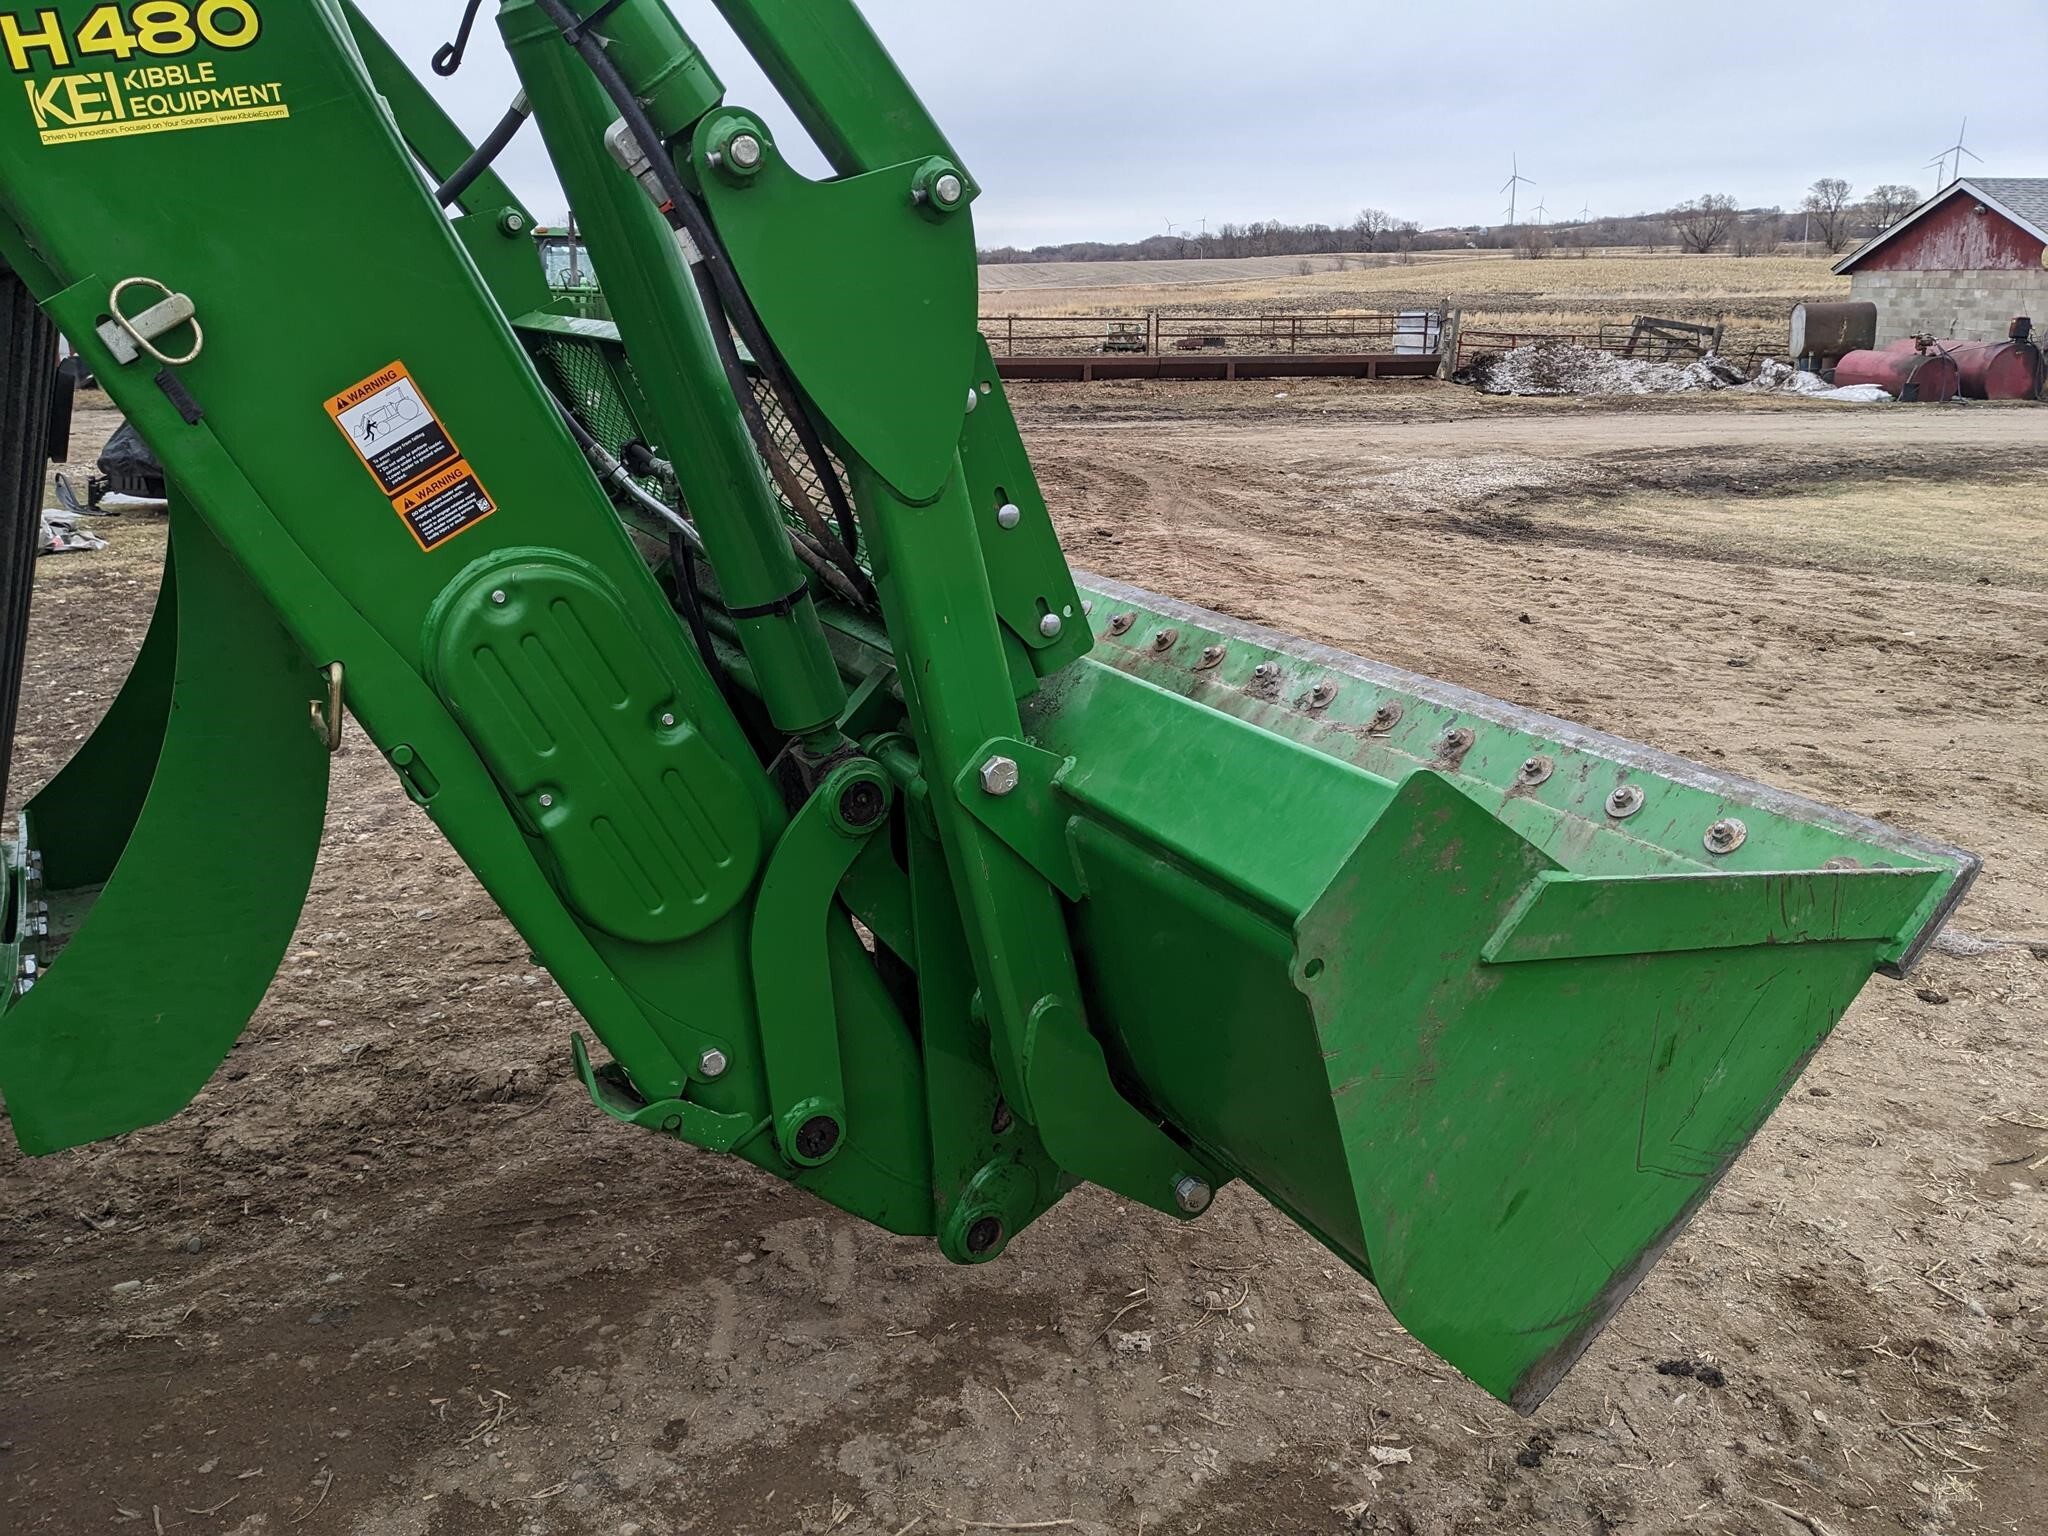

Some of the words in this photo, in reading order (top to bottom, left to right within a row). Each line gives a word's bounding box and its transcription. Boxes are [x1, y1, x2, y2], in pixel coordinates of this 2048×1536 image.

[123, 61, 217, 91] KIBBLE
[24, 71, 126, 128] KEI
[129, 82, 283, 118] EQUIPMENT
[41, 130, 67, 143] Driven
[68, 129, 77, 140] by
[119, 121, 150, 133] Focused
[151, 121, 162, 129] on
[161, 118, 179, 128] Your
[347, 370, 397, 402] WARNING
[379, 452, 390, 461] avoid
[390, 446, 402, 454] injury
[411, 432, 425, 441] falling
[386, 465, 400, 475] service
[400, 458, 412, 466] under
[416, 448, 429, 457] raised
[411, 443, 427, 454] perform
[388, 471, 401, 480] Lower
[401, 463, 414, 472] loader
[419, 451, 434, 462] ground
[433, 445, 445, 453] when
[415, 469, 463, 500] WARNING
[427, 497, 442, 507] operate
[441, 490, 453, 498] loader
